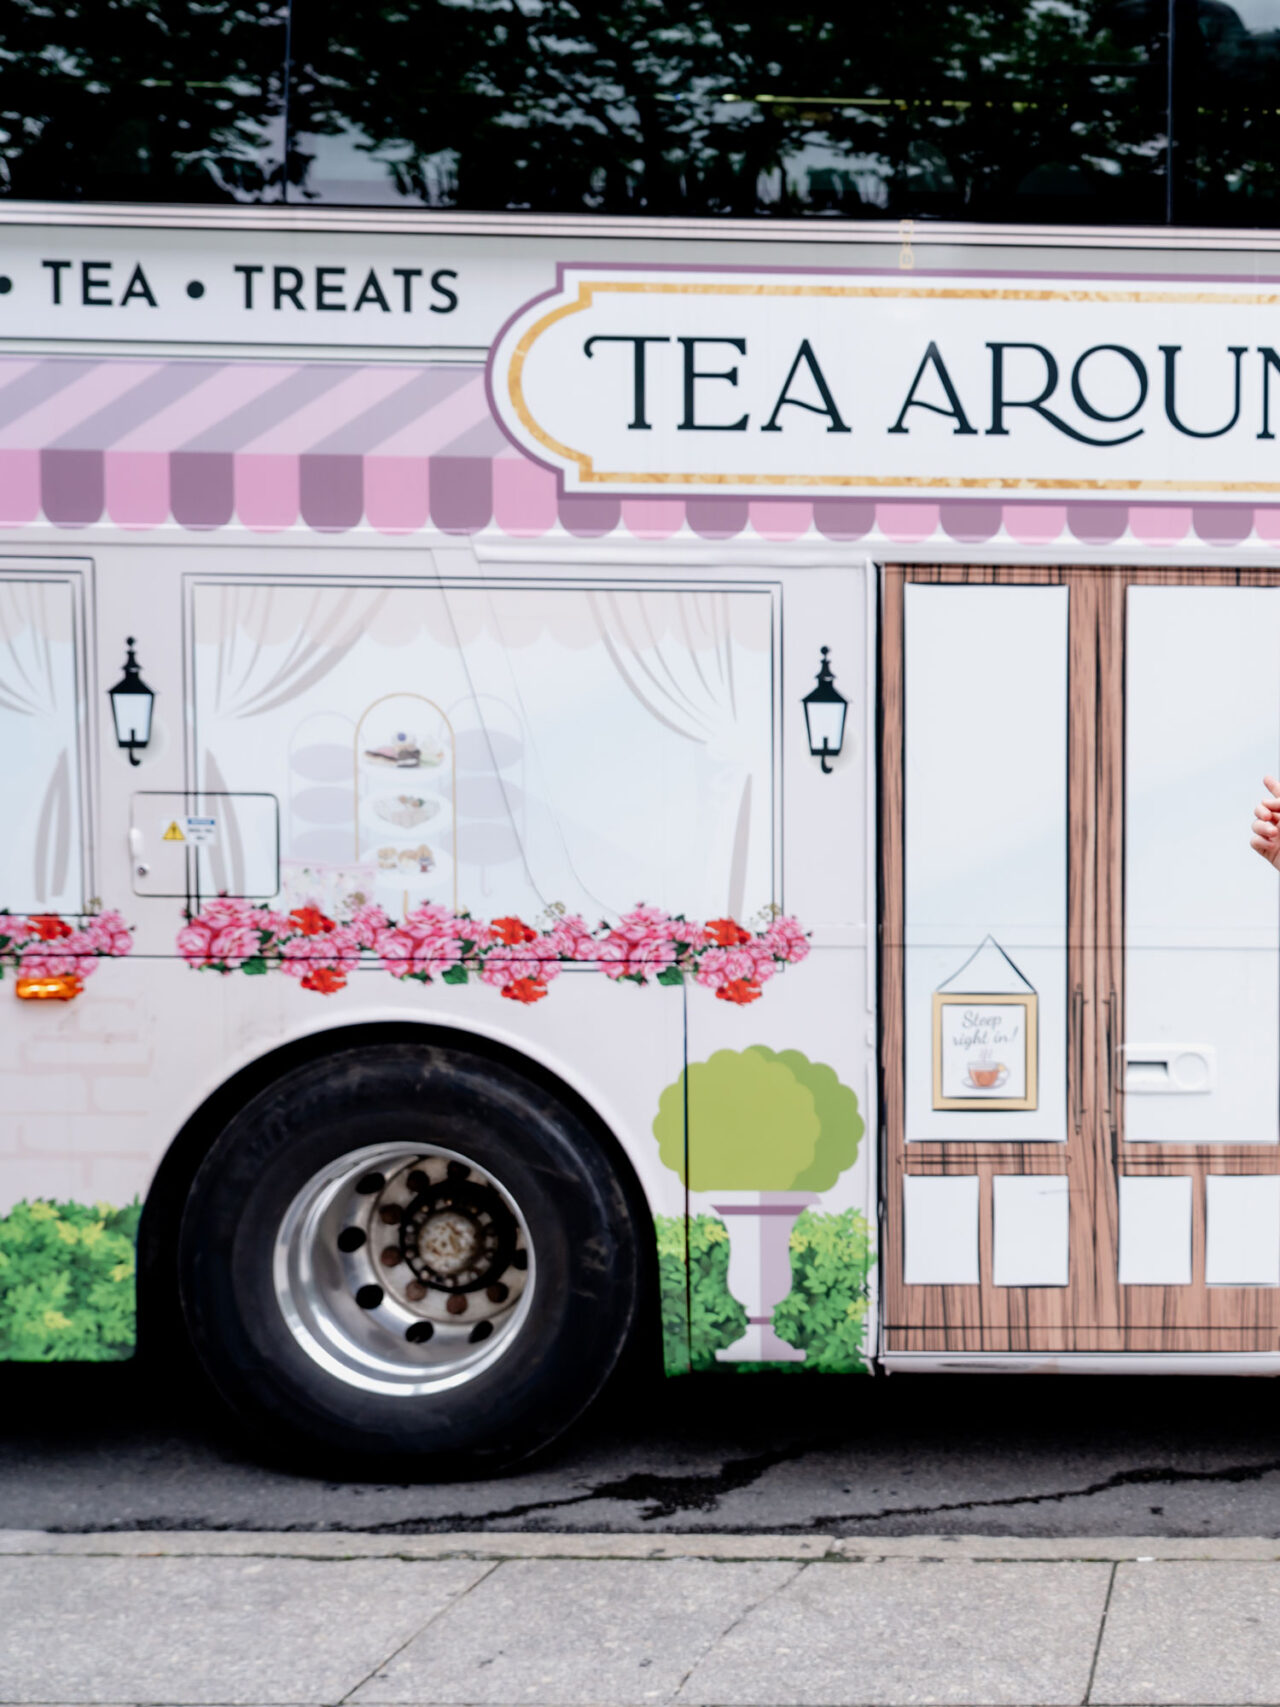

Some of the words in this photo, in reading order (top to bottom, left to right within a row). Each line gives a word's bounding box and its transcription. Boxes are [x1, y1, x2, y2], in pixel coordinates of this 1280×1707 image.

[41, 260, 158, 307] TEA
[233, 264, 459, 313] TREATS
[583, 335, 852, 433] TEA
[962, 1010, 1003, 1030] Step
[953, 1028, 987, 1051] right
